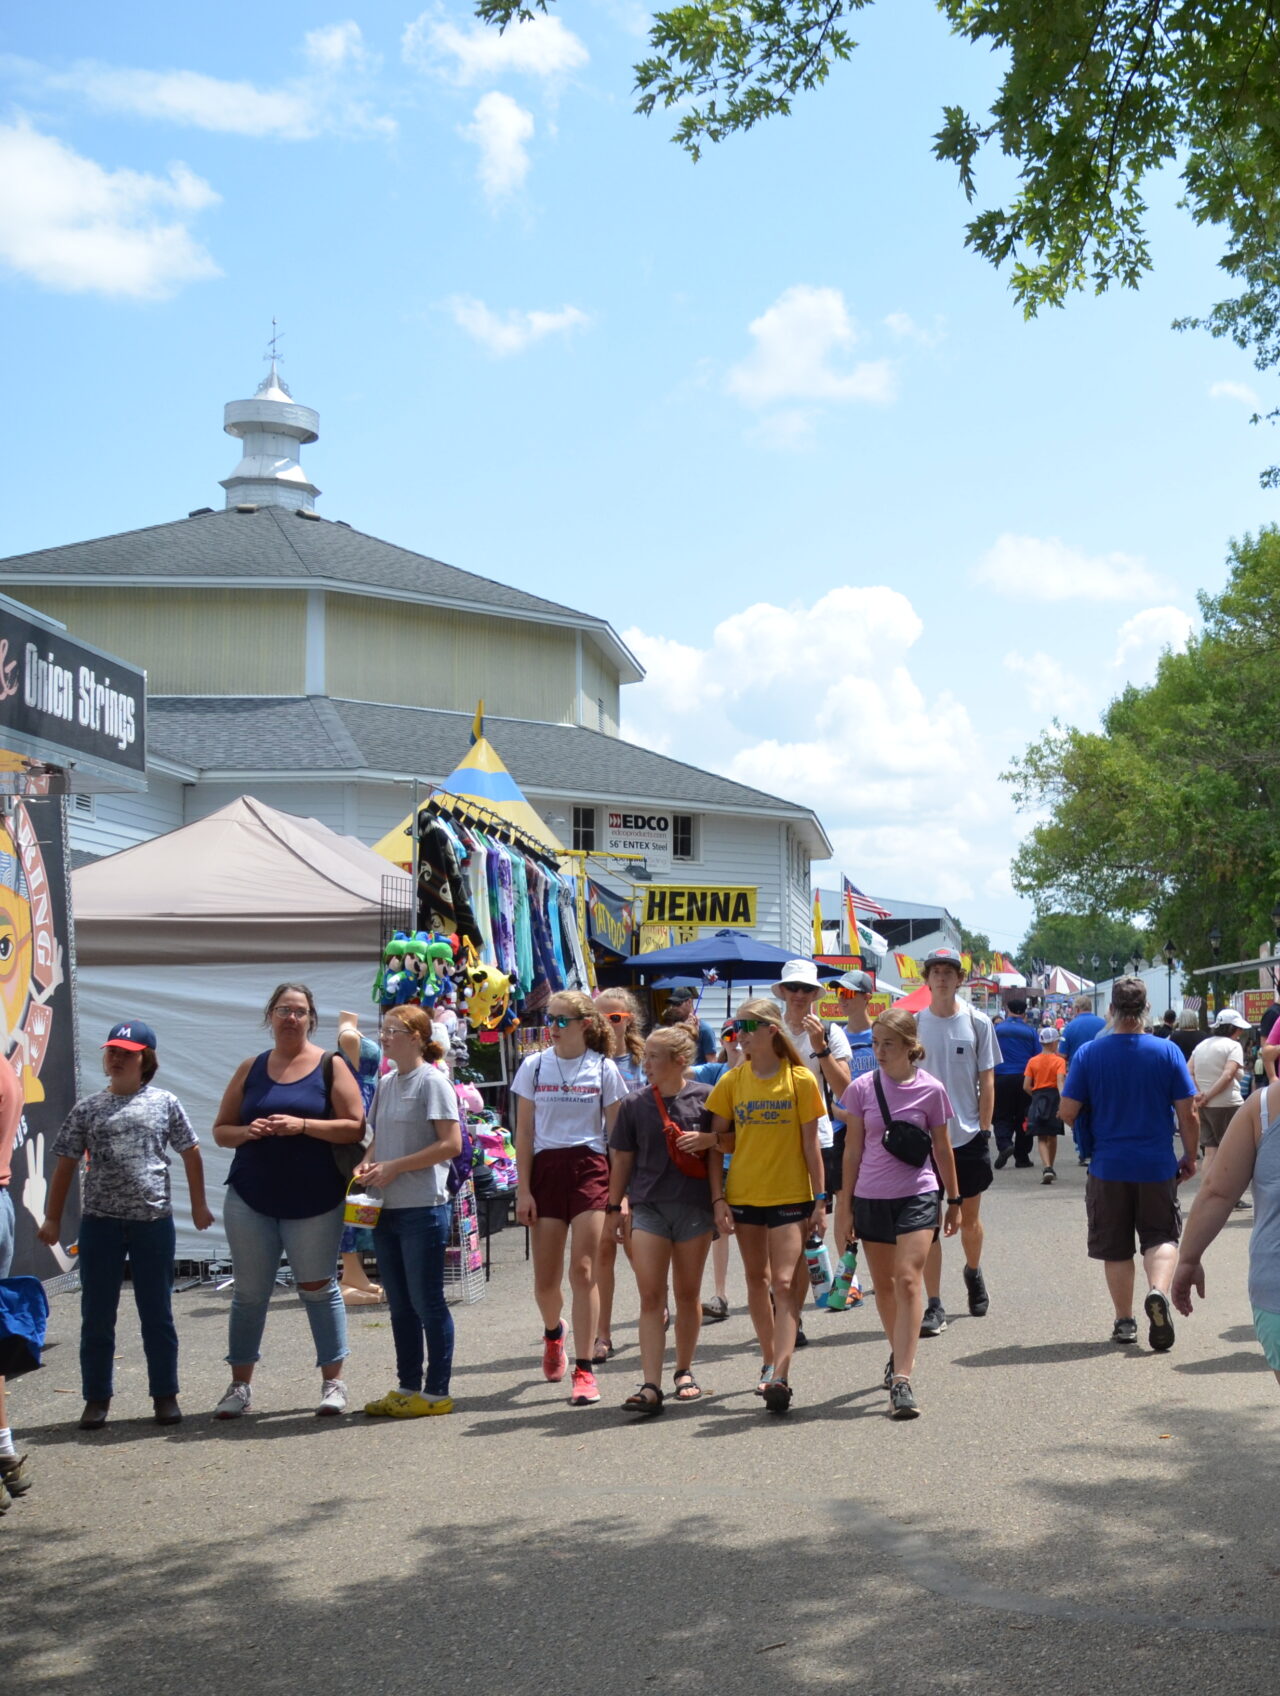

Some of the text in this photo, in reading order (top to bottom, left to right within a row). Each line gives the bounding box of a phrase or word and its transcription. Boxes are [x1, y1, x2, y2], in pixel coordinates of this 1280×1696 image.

[24, 642, 73, 721] Onion
[79, 666, 135, 751] Strings
[622, 814, 669, 832] EDCO
[623, 840, 650, 850] ENTEX
[652, 842, 668, 851] Steel
[646, 890, 751, 922] HENNA
[594, 903, 627, 950] TATTOOS
[117, 1026, 131, 1038] M
